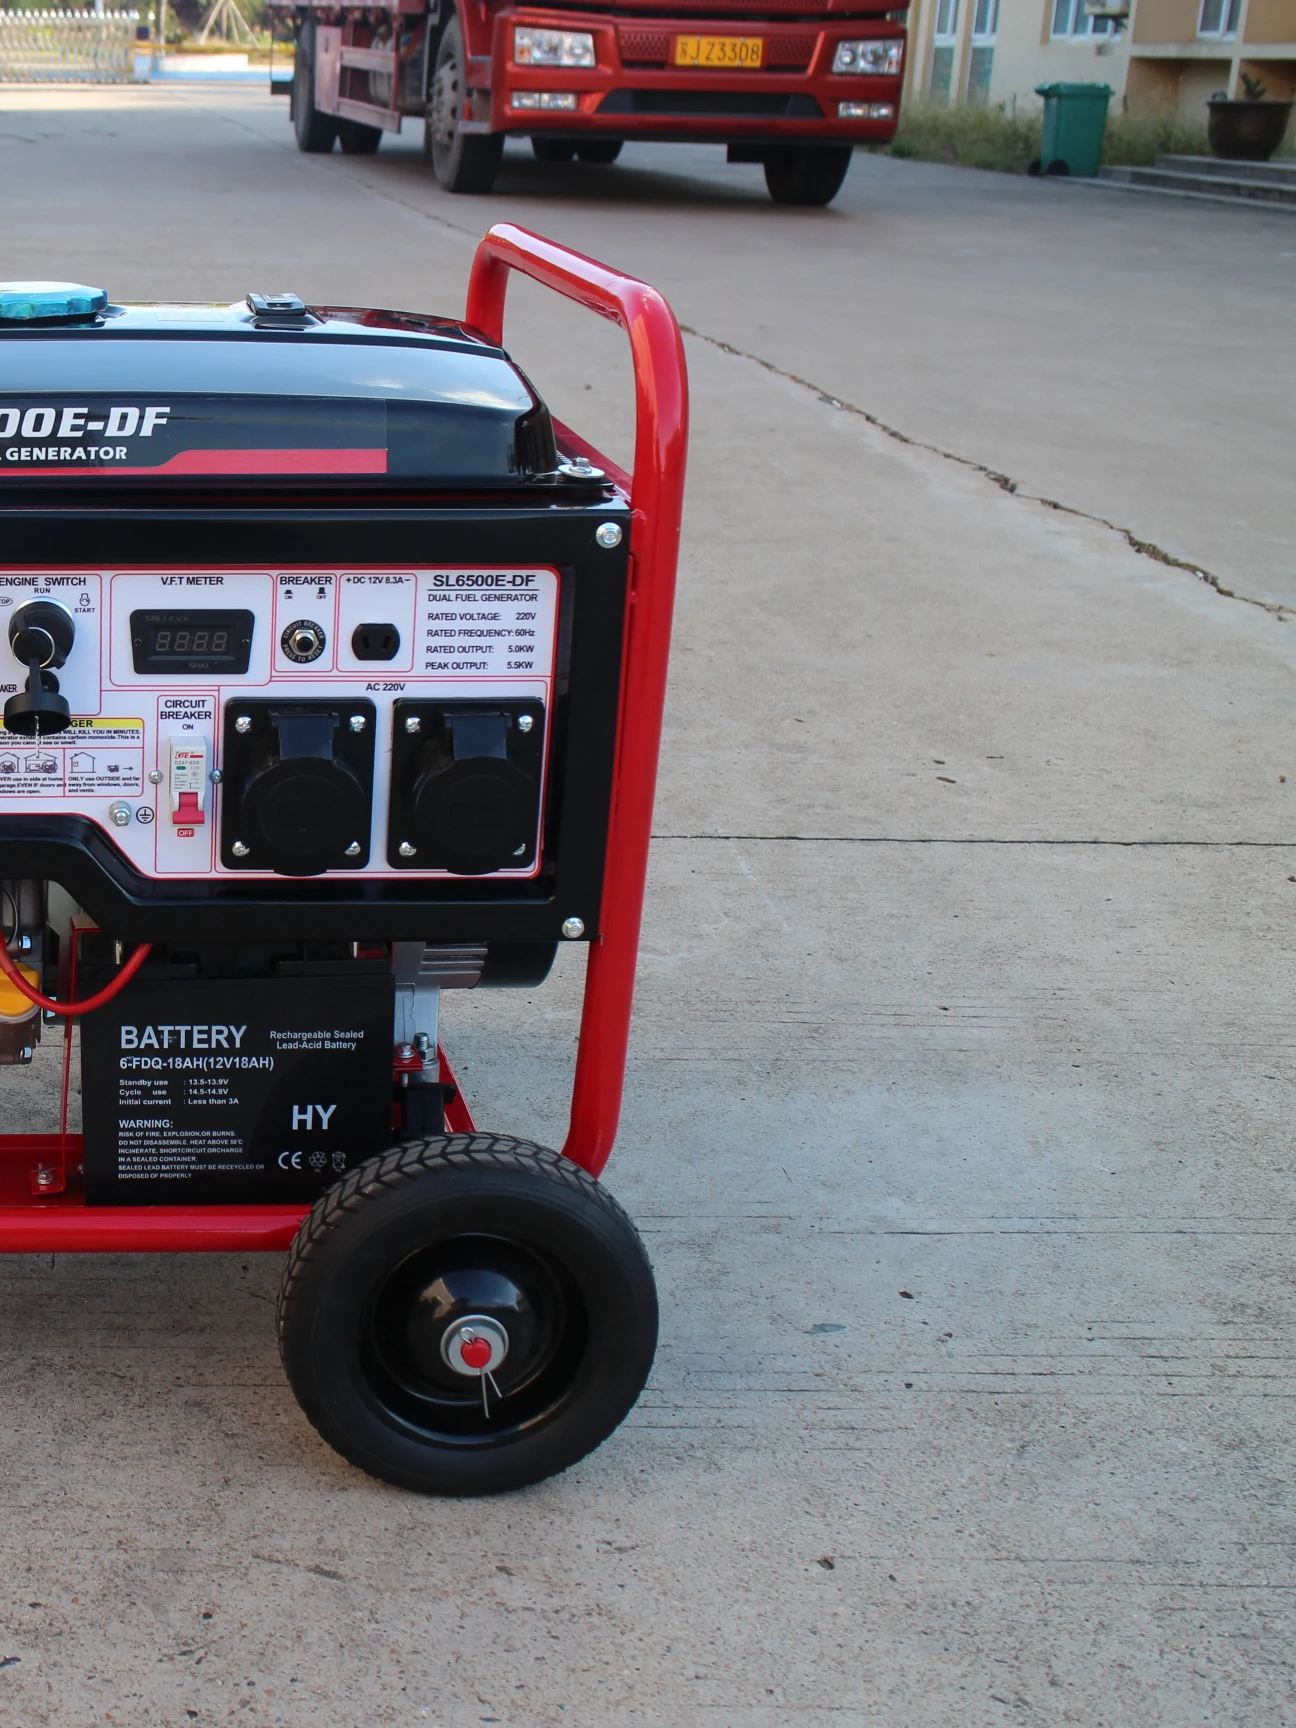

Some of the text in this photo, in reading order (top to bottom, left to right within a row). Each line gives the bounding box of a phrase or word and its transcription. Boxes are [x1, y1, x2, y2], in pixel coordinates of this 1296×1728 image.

[5, 446, 128, 461] GENERATOR
[44, 577, 87, 586] SWITCH
[161, 577, 224, 586] V.F.T METER
[279, 576, 333, 585] BREAKER
[432, 575, 536, 587] SL6500E-DF
[427, 594, 538, 602] DUAL FUEL GENERATOR
[427, 612, 537, 621] RATED VOLTAGE: 220V
[283, 621, 325, 639] CIRCUIT BREAKER
[426, 629, 456, 637] RATED
[458, 629, 514, 637] FREQUENCY:
[283, 644, 297, 660] PRESS
[308, 645, 323, 660] RESET
[507, 645, 535, 653] 5.0KW
[507, 661, 533, 669] 5.5KW
[365, 683, 406, 691] AC 220V
[164, 700, 207, 708] CIRCUIT
[160, 711, 212, 720] BREAKER
[178, 829, 194, 837] OFF
[121, 1025, 247, 1049] BATTERY
[270, 1030, 364, 1040] Rechargeable Sealed
[276, 1041, 357, 1050] Lead-Acid Battery
[119, 1056, 274, 1071] 6-FDQ-18AH(12V18AH)
[119, 1079, 152, 1087] Standby
[119, 1089, 142, 1097] Cycle
[292, 1104, 337, 1130] HY
[118, 1119, 174, 1129] WARNING:
